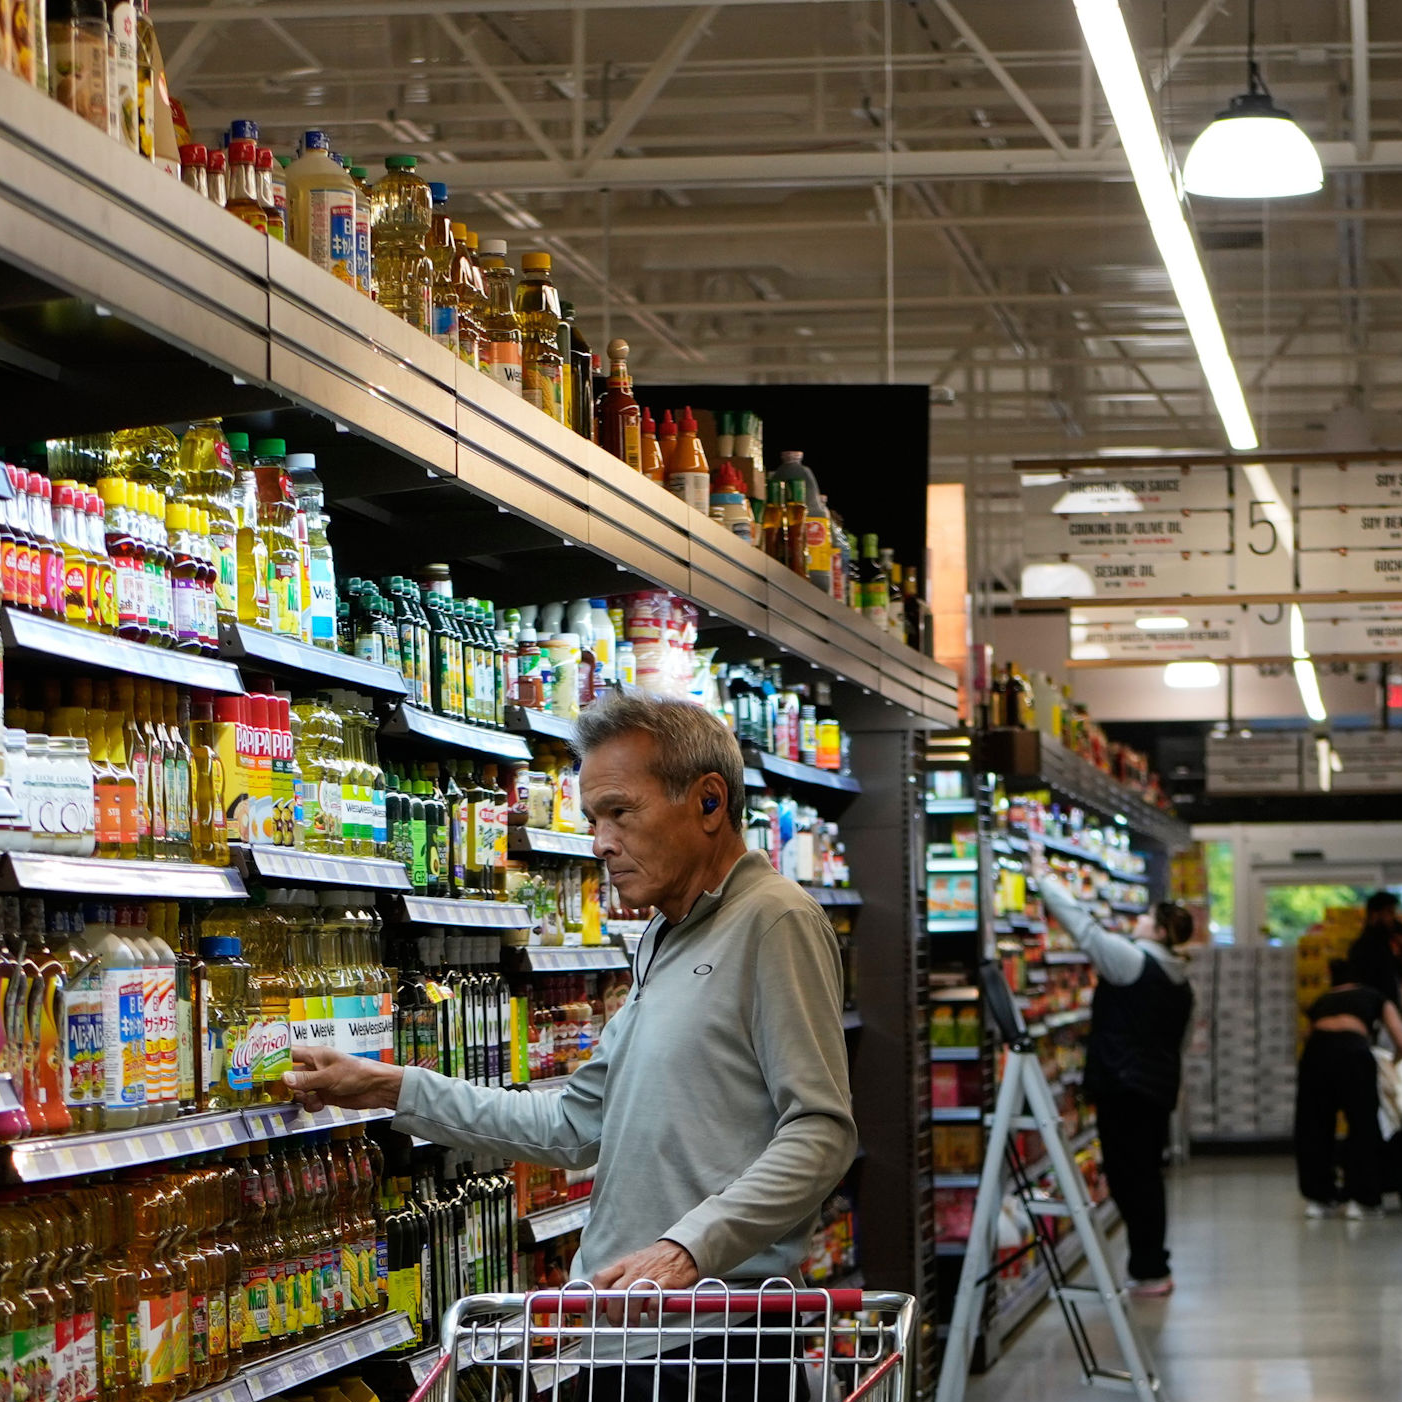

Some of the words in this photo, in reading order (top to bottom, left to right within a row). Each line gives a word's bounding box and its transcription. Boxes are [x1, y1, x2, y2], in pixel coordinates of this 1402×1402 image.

[1375, 473, 1396, 487] SOY
[1069, 522, 1112, 535] COOKING
[1167, 521, 1183, 534] OIL
[1248, 501, 1277, 556] 5
[1361, 516, 1381, 530] SOY
[1094, 565, 1136, 578] SESAME
[1139, 565, 1156, 577] OIL
